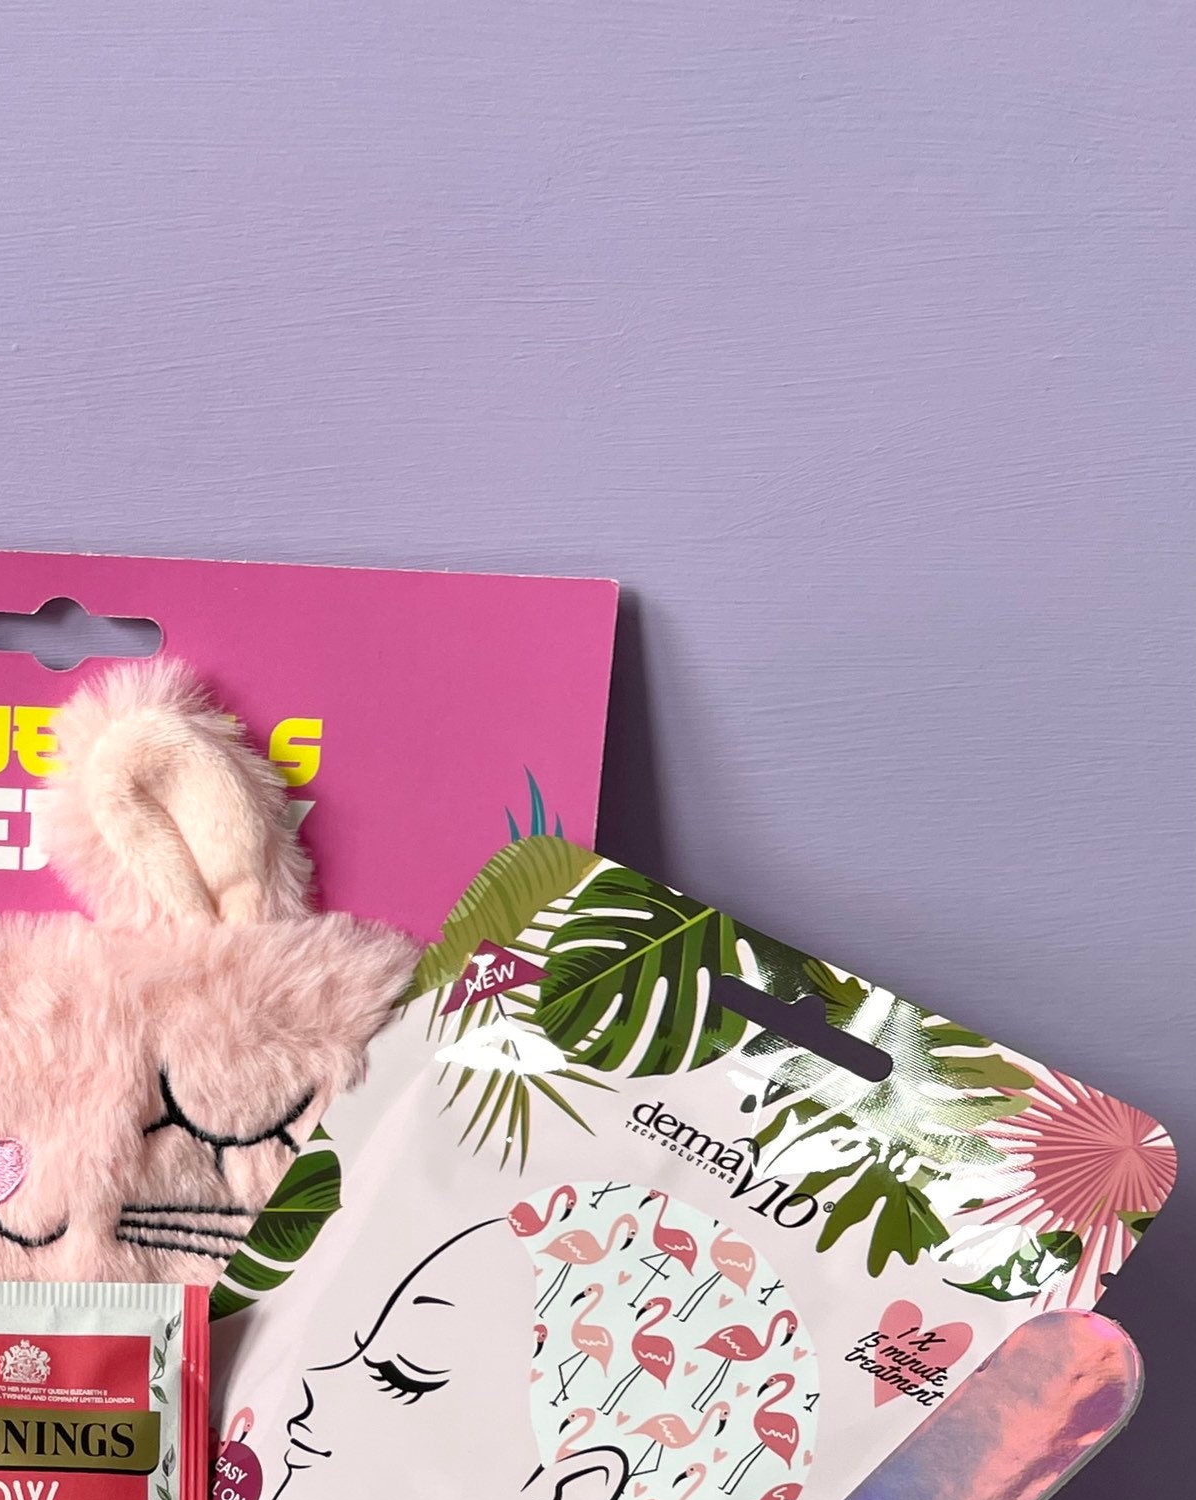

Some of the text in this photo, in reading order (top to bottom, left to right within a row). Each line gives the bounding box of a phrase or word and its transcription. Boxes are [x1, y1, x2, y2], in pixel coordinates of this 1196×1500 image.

[464, 960, 516, 993] NEW
[624, 1120, 735, 1185] TECH SOLUTIONS
[896, 1326, 920, 1340] 1
[857, 1330, 949, 1387] 15 minute
[47, 1387, 70, 1396] QUEEN
[844, 1346, 945, 1407] treatment
[2, 1392, 32, 1401] TWINING
[32, 1394, 47, 1402] AND
[47, 1395, 79, 1404] COMPANY
[214, 1456, 249, 1485] EASY
